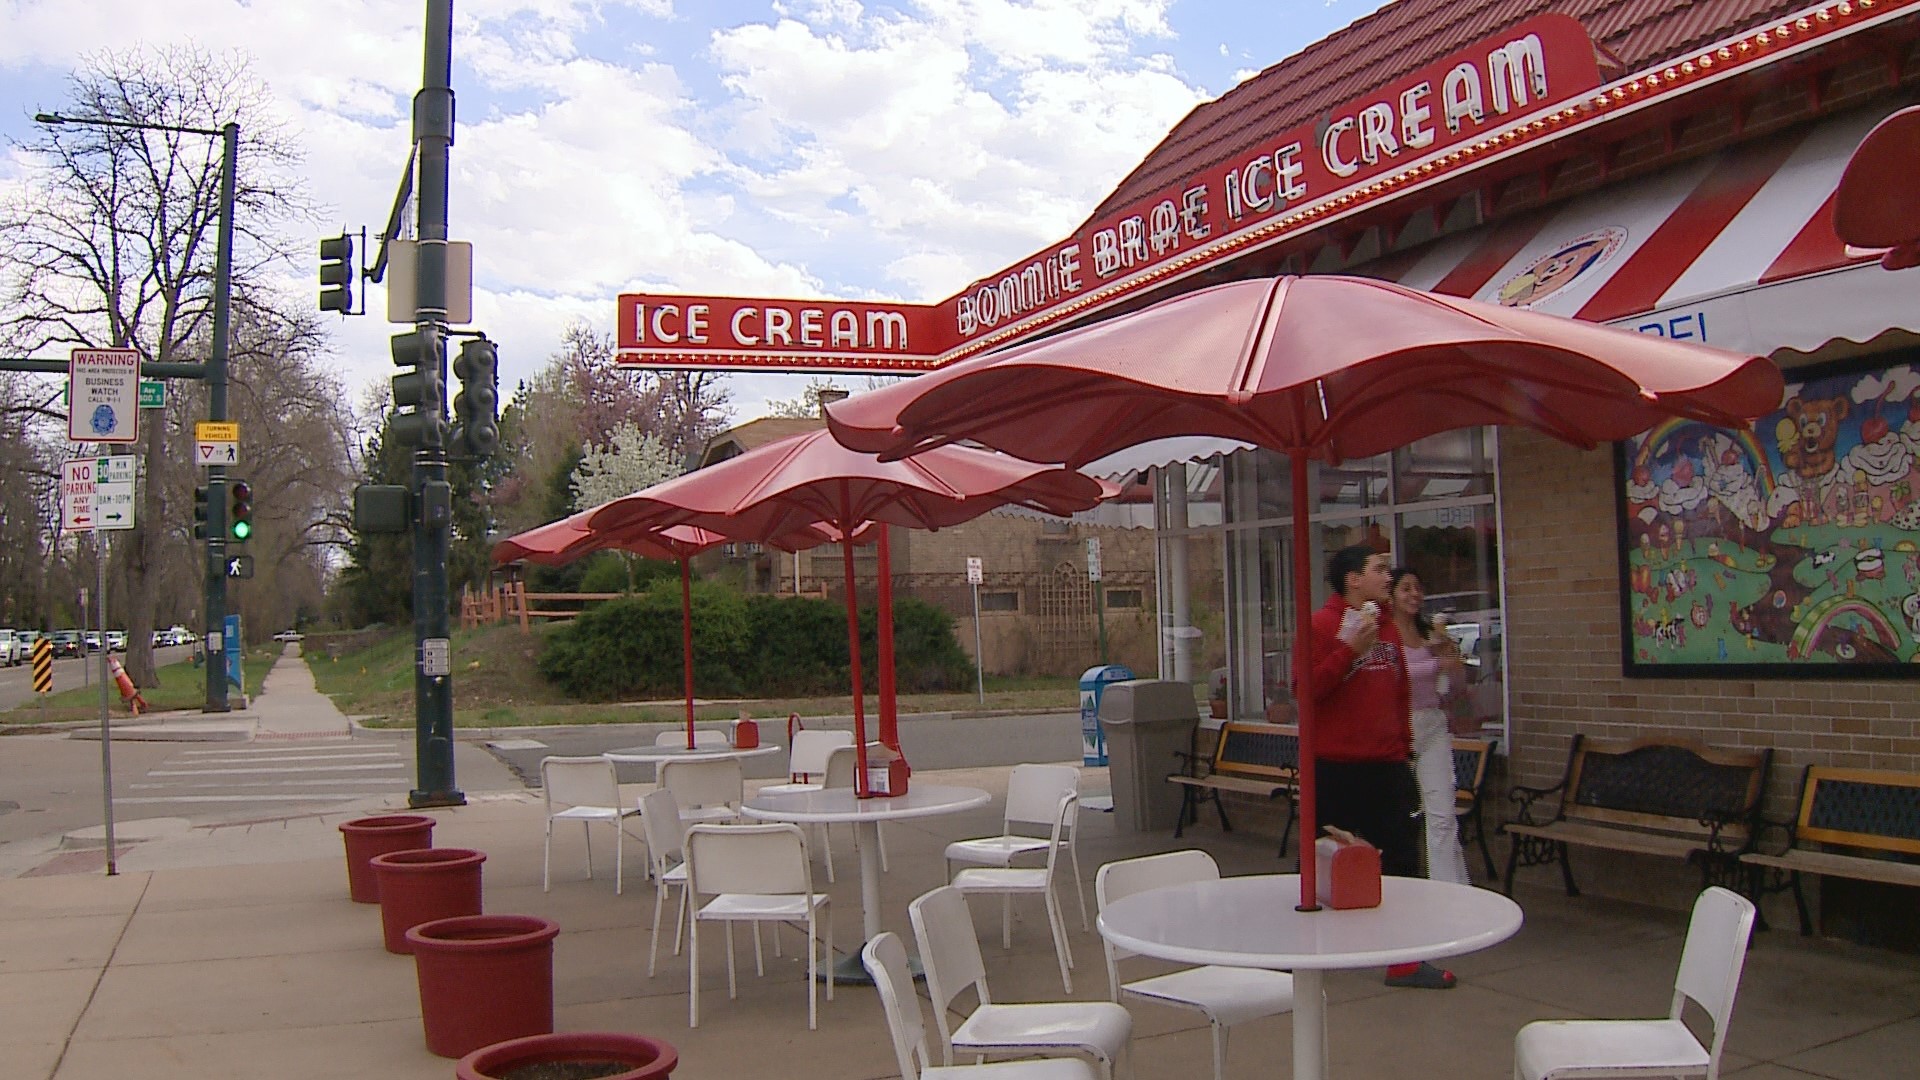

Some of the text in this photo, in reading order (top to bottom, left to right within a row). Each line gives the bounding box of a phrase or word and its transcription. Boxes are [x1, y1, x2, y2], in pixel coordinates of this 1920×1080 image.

[955, 32, 1549, 337] BONNIE BRAE ICE CREAM
[635, 302, 908, 350] ICE CREAM
[77, 353, 135, 366] WARNING
[85, 377, 125, 386] BUSINESS
[91, 387, 119, 396] WATCH
[115, 461, 127, 469] MIN
[72, 466, 90, 481] NO
[109, 471, 133, 480] PARKING
[65, 481, 97, 495] PARKING
[73, 495, 89, 504] ANY
[72, 505, 91, 514] TIME
